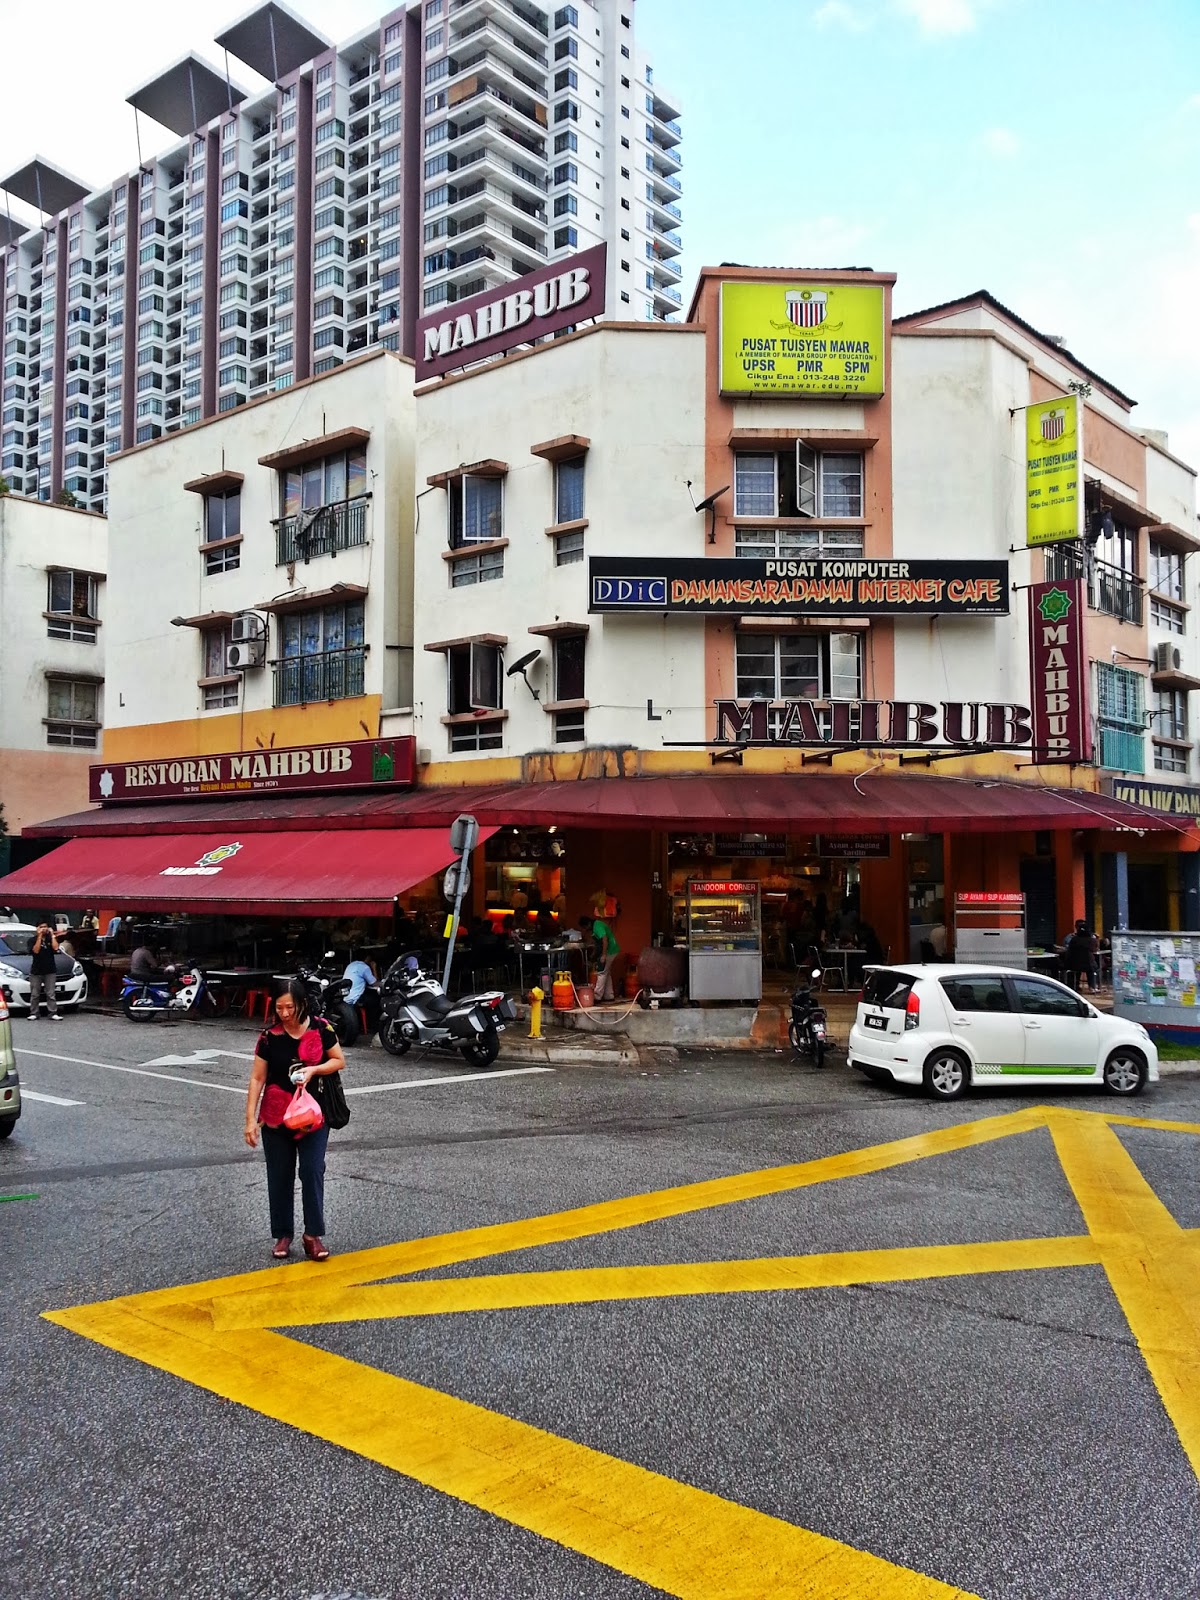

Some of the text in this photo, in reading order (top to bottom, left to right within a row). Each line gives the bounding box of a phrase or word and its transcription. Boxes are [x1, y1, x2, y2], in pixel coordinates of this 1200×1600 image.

[423, 267, 592, 363] MAHBUB
[742, 338, 870, 353] PUSAT TUISYEN MAWAR
[742, 359, 870, 373] UPSR PMR SPM
[1028, 458, 1041, 470] PUSAT
[1028, 481, 1077, 497] UPSR PMR SPM
[766, 561, 910, 578] PUSAT KOMPUTER
[858, 578, 946, 604] INTERNET
[947, 578, 1003, 604] CAFE
[1042, 624, 1070, 759] MAHBUB
[713, 699, 1033, 745] MAHBUB
[124, 746, 352, 787] RESTORAN MAHBUB
[693, 883, 725, 891] TANDOORI
